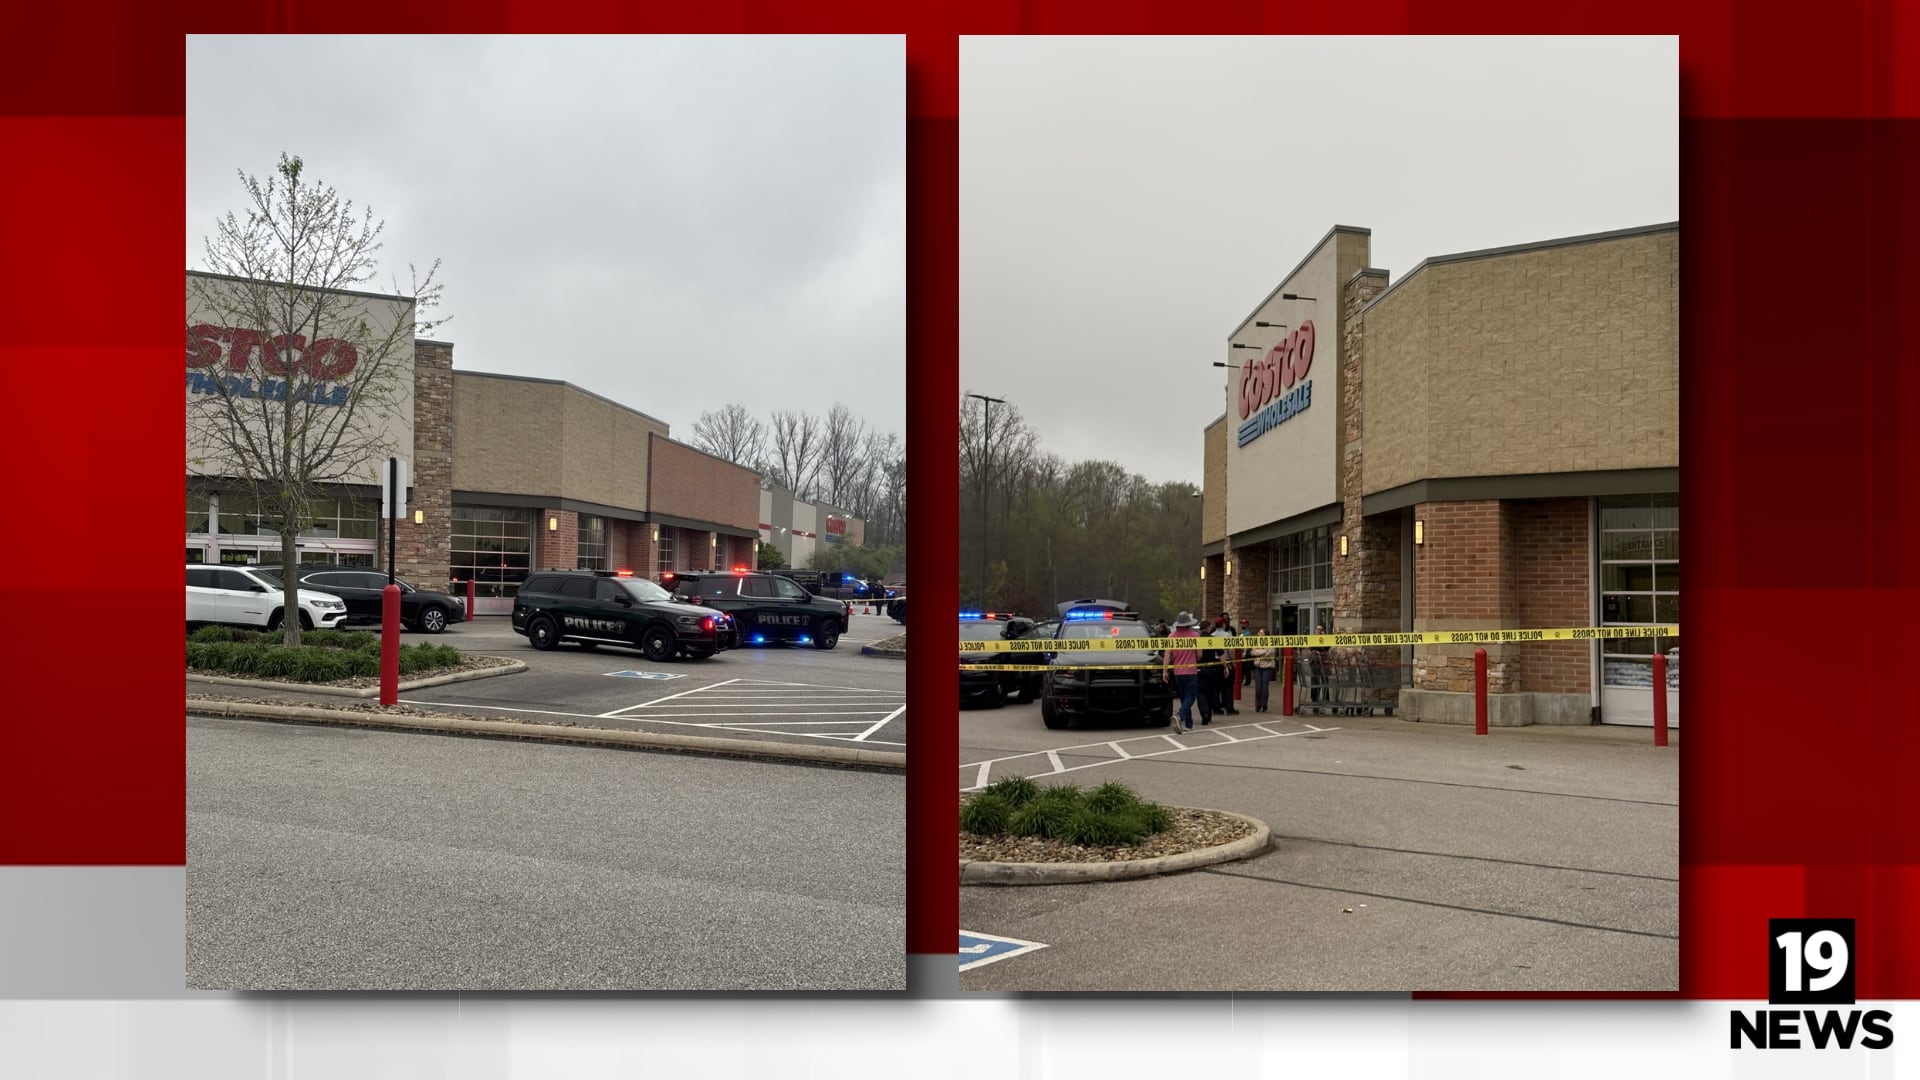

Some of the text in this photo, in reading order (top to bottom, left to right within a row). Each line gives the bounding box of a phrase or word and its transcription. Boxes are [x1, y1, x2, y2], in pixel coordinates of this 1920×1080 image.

[1238, 319, 1316, 420] COSTCO
[1257, 380, 1313, 436] WHOLESALE
[564, 616, 615, 632] POLICE
[758, 614, 800, 625] POLICE
